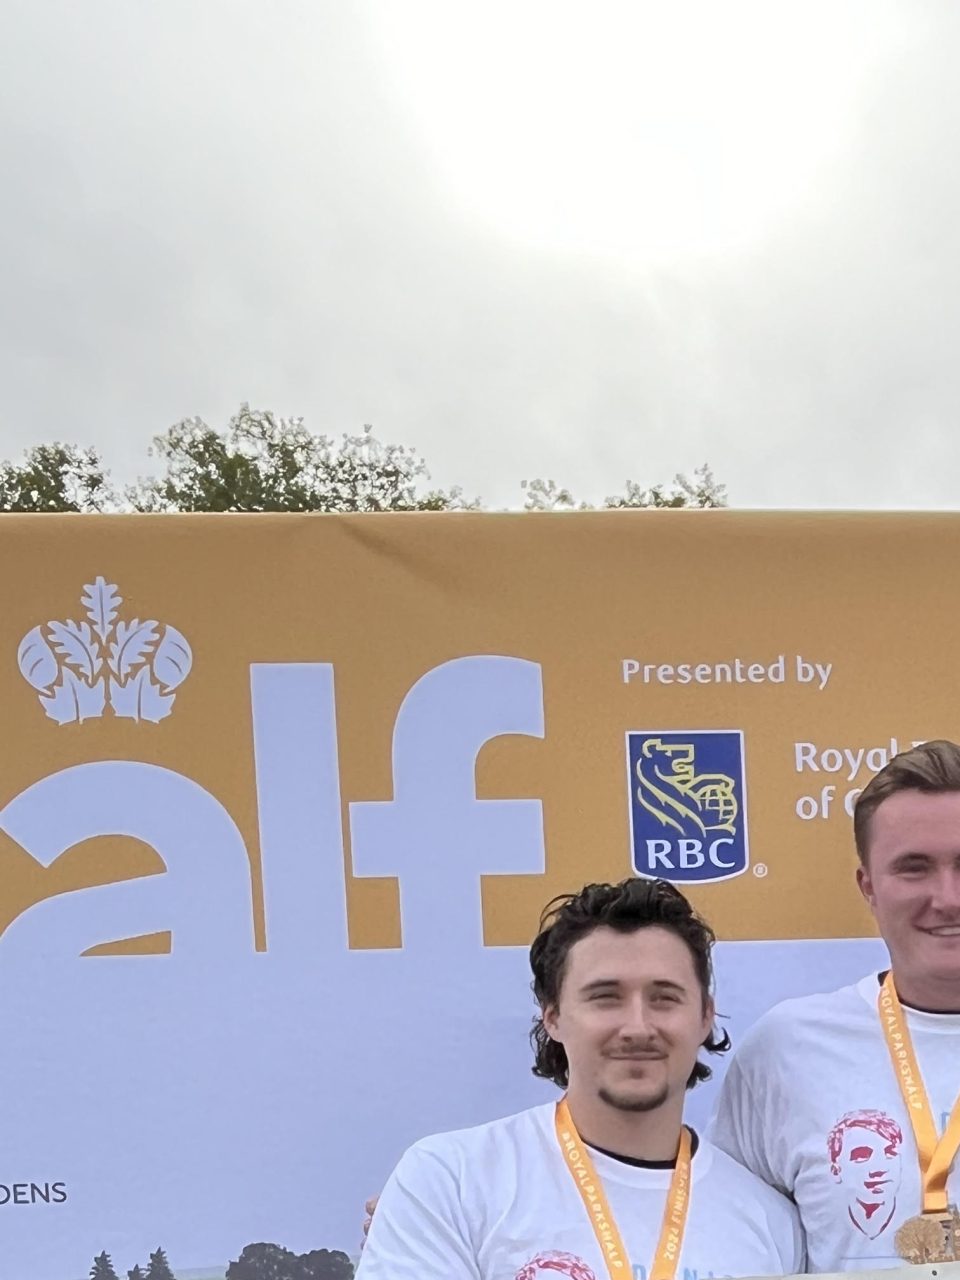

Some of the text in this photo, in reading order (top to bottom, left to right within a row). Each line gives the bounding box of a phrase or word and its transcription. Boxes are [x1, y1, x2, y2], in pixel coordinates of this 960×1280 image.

[622, 656, 832, 690] Presented by
[794, 737, 897, 781] Royal
[0, 655, 545, 952] alf
[795, 785, 837, 820] of
[646, 839, 736, 869] RBC
